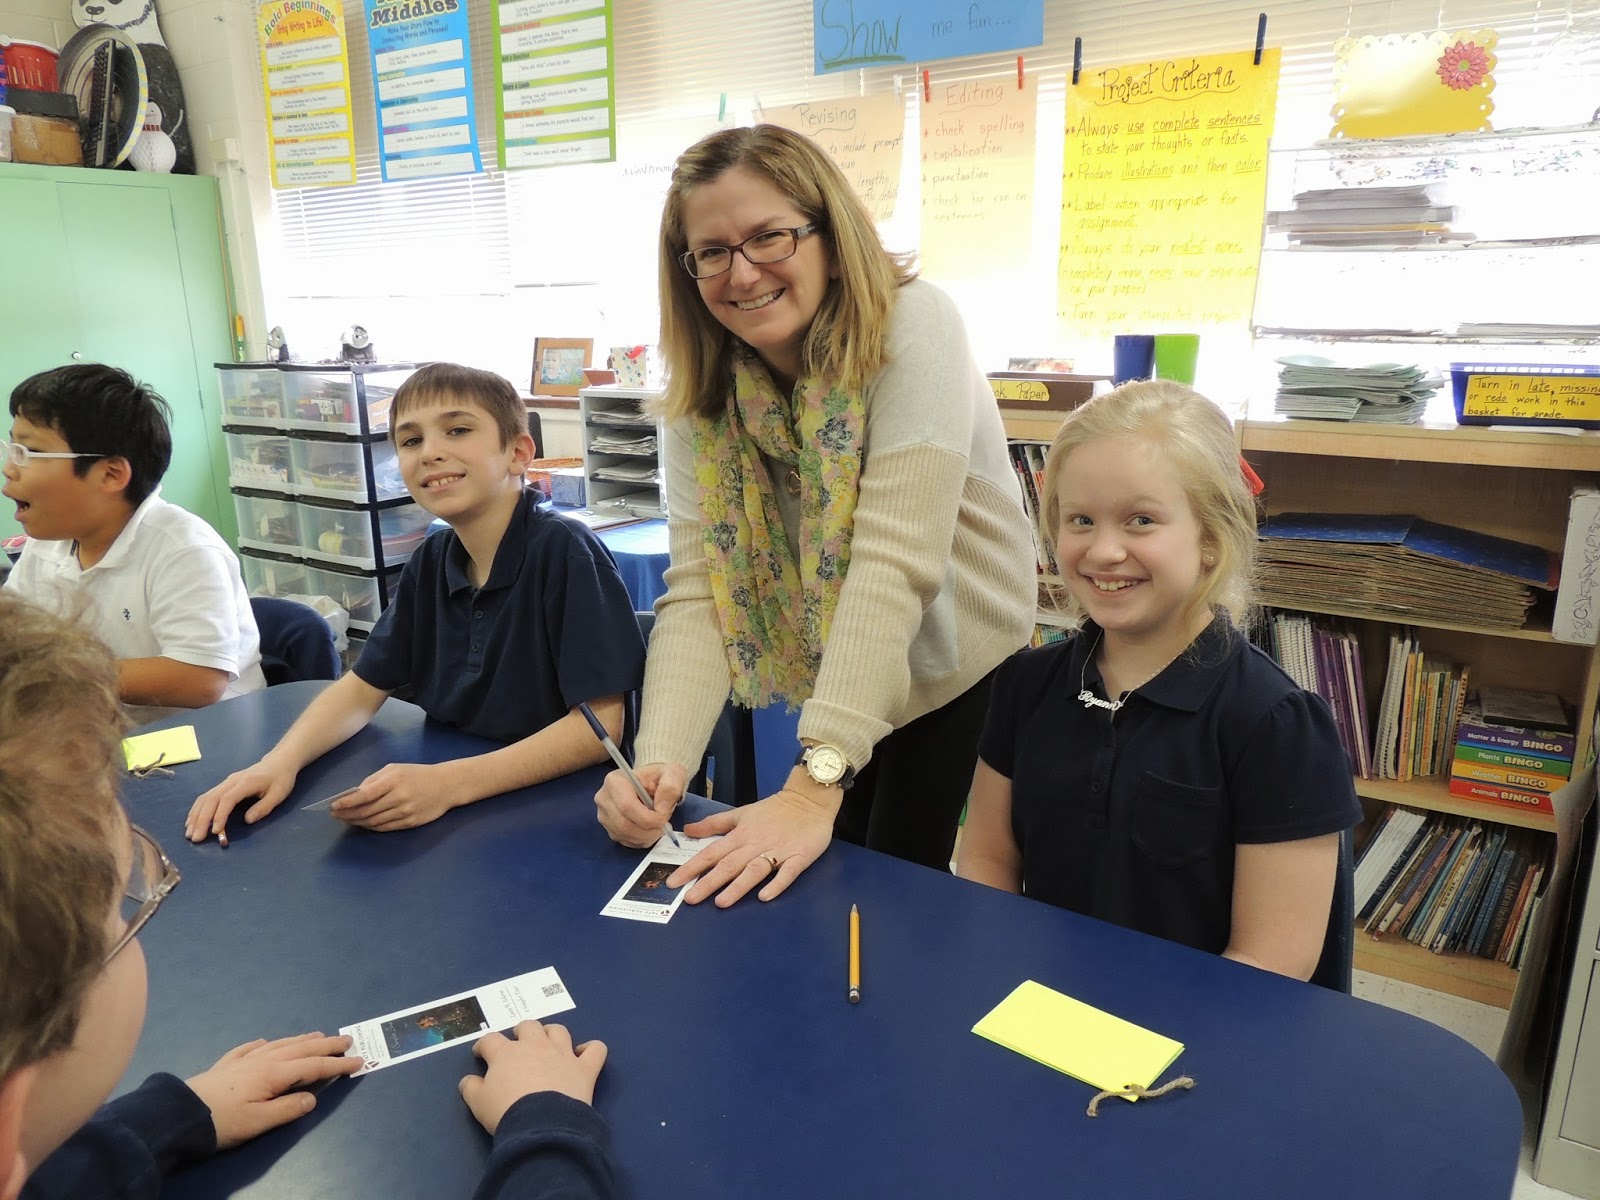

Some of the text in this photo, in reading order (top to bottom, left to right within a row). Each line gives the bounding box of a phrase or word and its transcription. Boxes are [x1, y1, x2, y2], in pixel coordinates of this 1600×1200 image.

[264, 0, 336, 36] Bold Beginnings
[371, 0, 458, 26] Middles
[820, 0, 902, 61] Show
[931, 20, 953, 38] me
[1097, 59, 1236, 104] Project Criteria
[946, 81, 1004, 106] Editing
[792, 102, 857, 129] Revising
[935, 114, 1025, 138] check spelling
[1076, 110, 1262, 139] Always use complete sentences
[829, 142, 838, 154] to
[872, 131, 904, 152] prompt
[1081, 139, 1091, 156] to
[1096, 139, 1118, 155] state
[1125, 141, 1144, 158] your
[1152, 135, 1193, 154] thoughts
[1201, 136, 1212, 146] or
[932, 167, 990, 188] punctuation
[1077, 162, 1113, 181] Produce
[1181, 155, 1200, 174] and
[1207, 158, 1228, 172] then
[1074, 192, 1105, 211] Label
[1148, 192, 1208, 211] appropriate
[1016, 381, 1047, 400] Paper
[1474, 376, 1500, 389] Turn
[1509, 380, 1519, 390] in
[1528, 377, 1555, 395] late,
[1485, 394, 1508, 403] redo
[1516, 395, 1541, 405] work
[1549, 395, 1558, 406] in
[1565, 397, 1586, 406] this
[1467, 406, 1565, 419] basket for grade.
[1456, 693, 1464, 718] BOTTLE
[1467, 732, 1490, 742] Matter
[1497, 736, 1519, 746] Energy
[1522, 739, 1563, 753] BINGO
[1477, 752, 1544, 769] Plants BINGO
[1471, 769, 1547, 788] Weather BINGO
[1471, 787, 1540, 805] Animals BINGO
